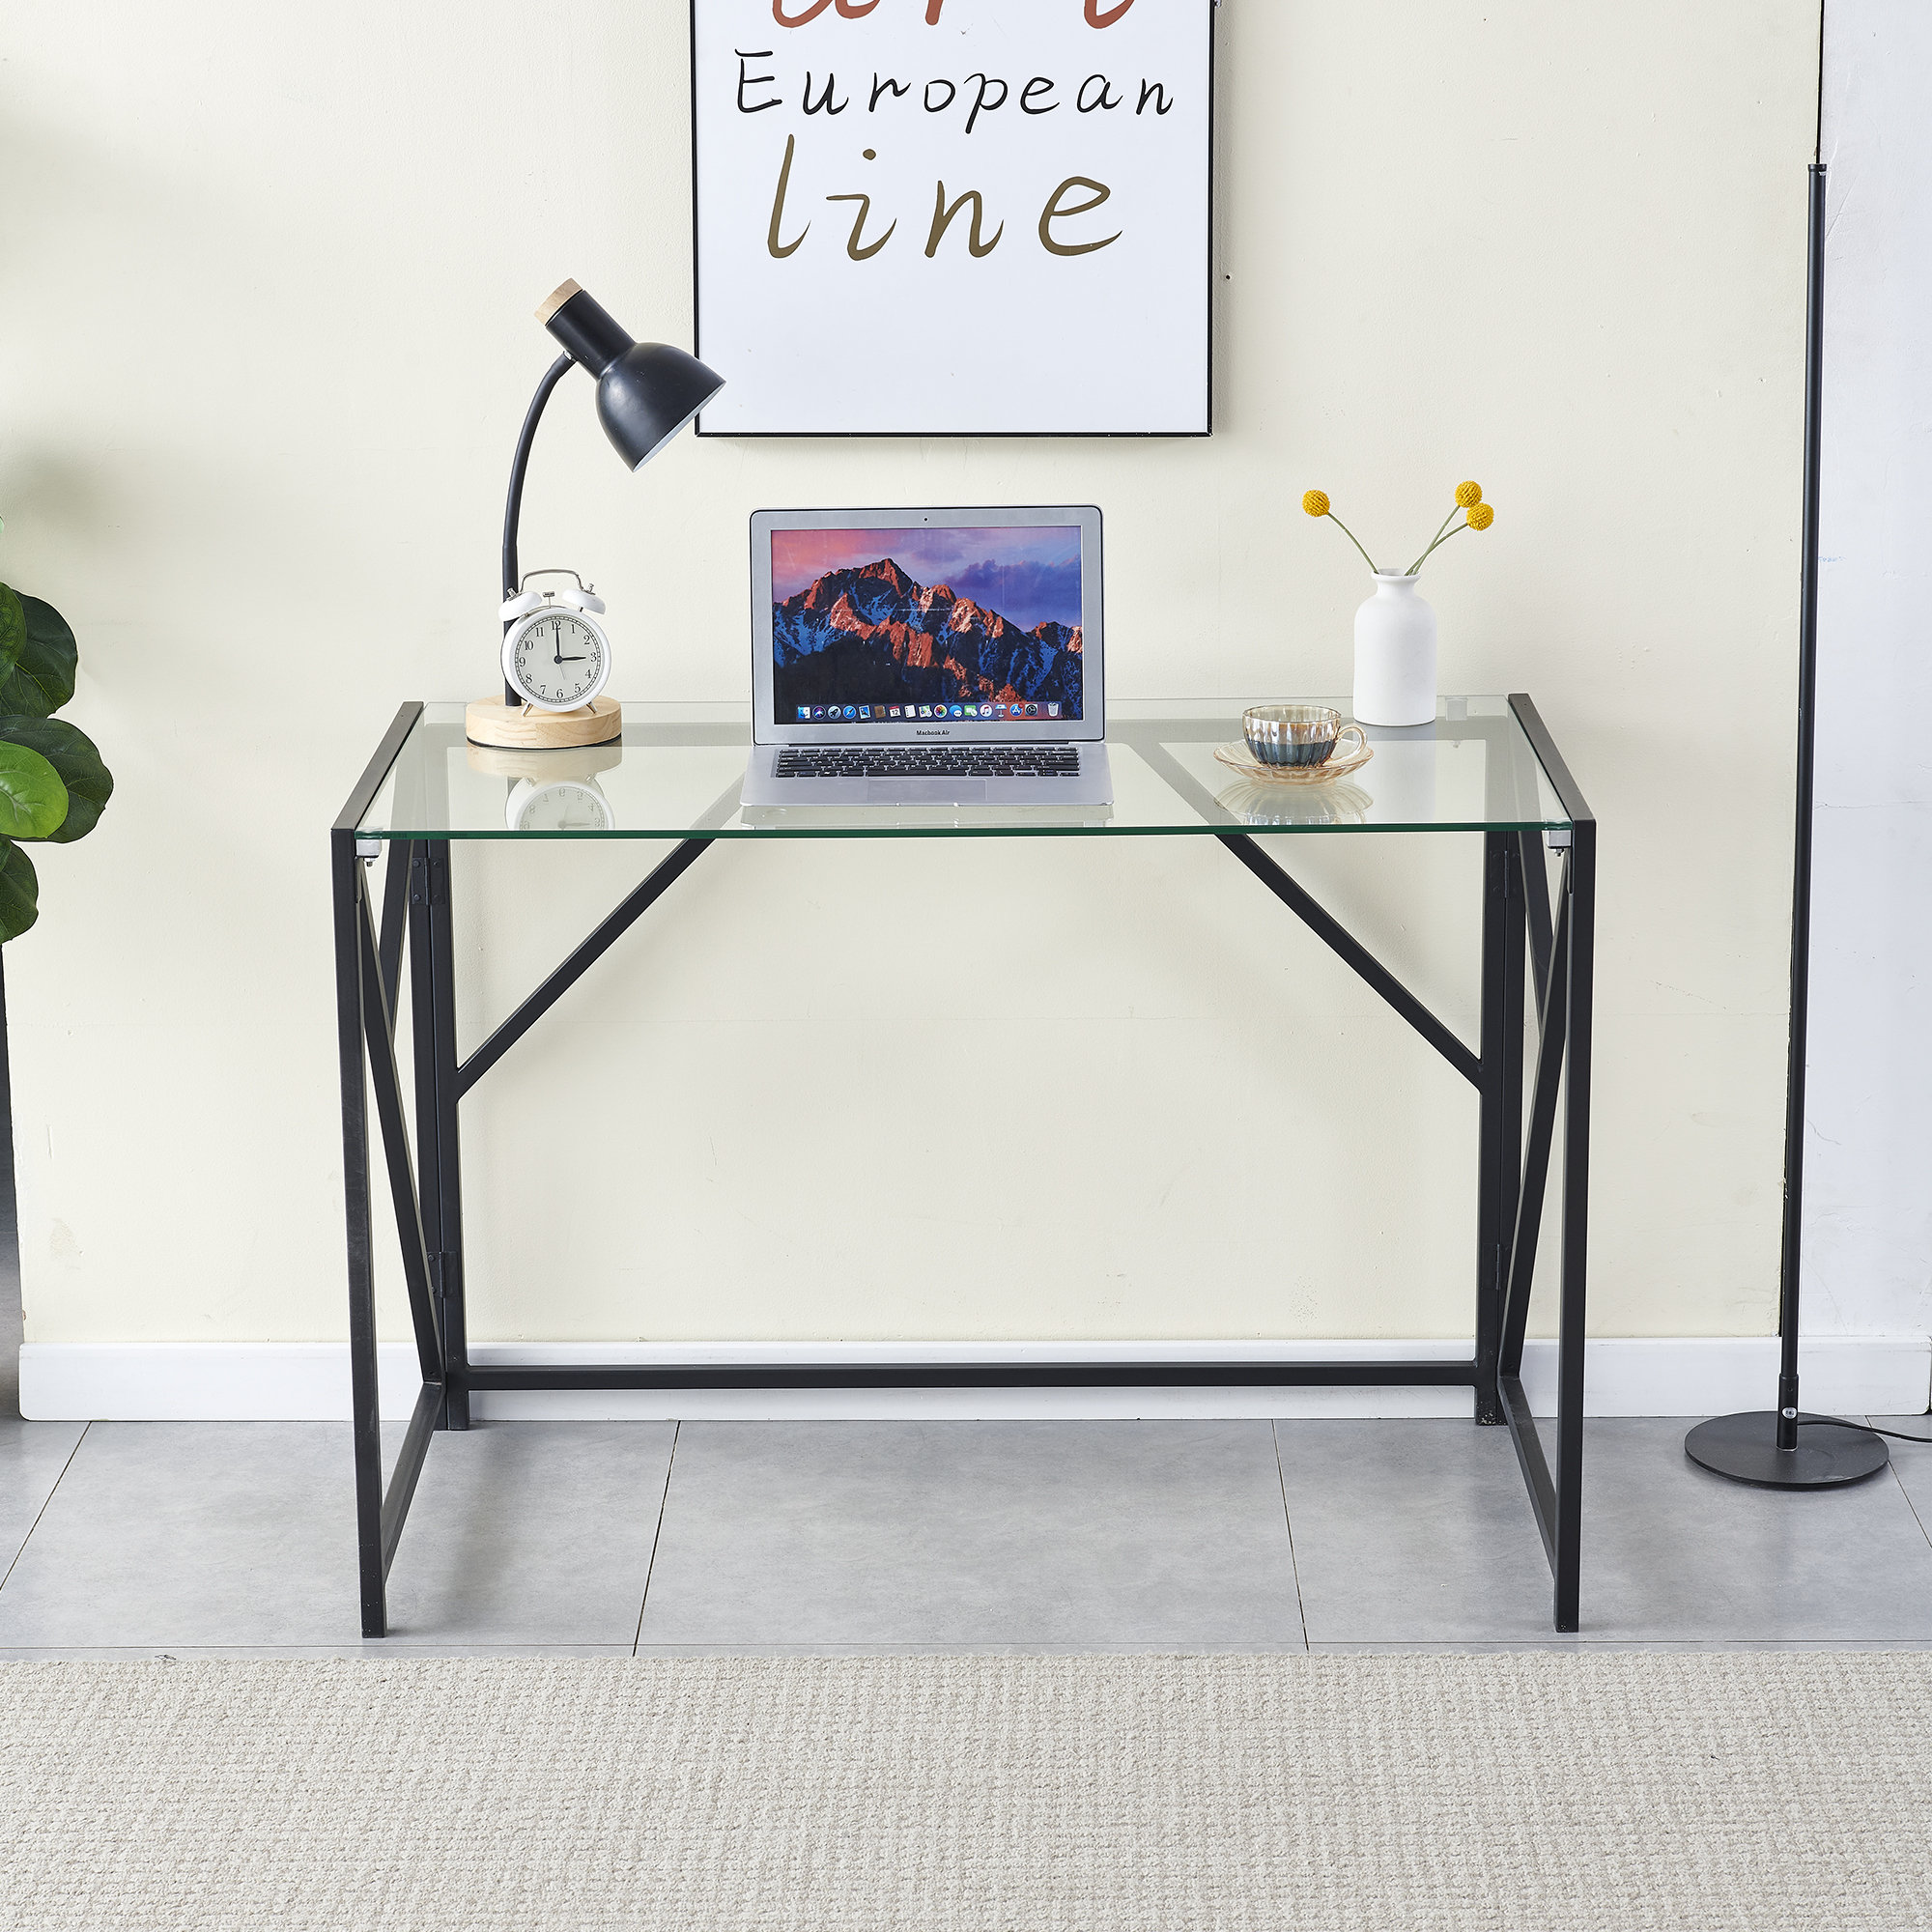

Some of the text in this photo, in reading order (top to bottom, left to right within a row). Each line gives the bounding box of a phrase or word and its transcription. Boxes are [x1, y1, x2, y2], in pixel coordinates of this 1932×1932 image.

[734, 48, 1174, 134] European
[768, 133, 1122, 261] line
[552, 620, 561, 631] 12
[571, 624, 577, 634] 1
[535, 627, 544, 638] 11
[525, 640, 533, 650] 10
[583, 635, 591, 645] 2
[519, 657, 526, 668] 9
[590, 652, 597, 663] 3
[526, 673, 532, 684] 8
[584, 669, 592, 679] 4
[540, 684, 547, 695] 7
[556, 689, 564, 698] 6
[574, 683, 582, 694] 5
